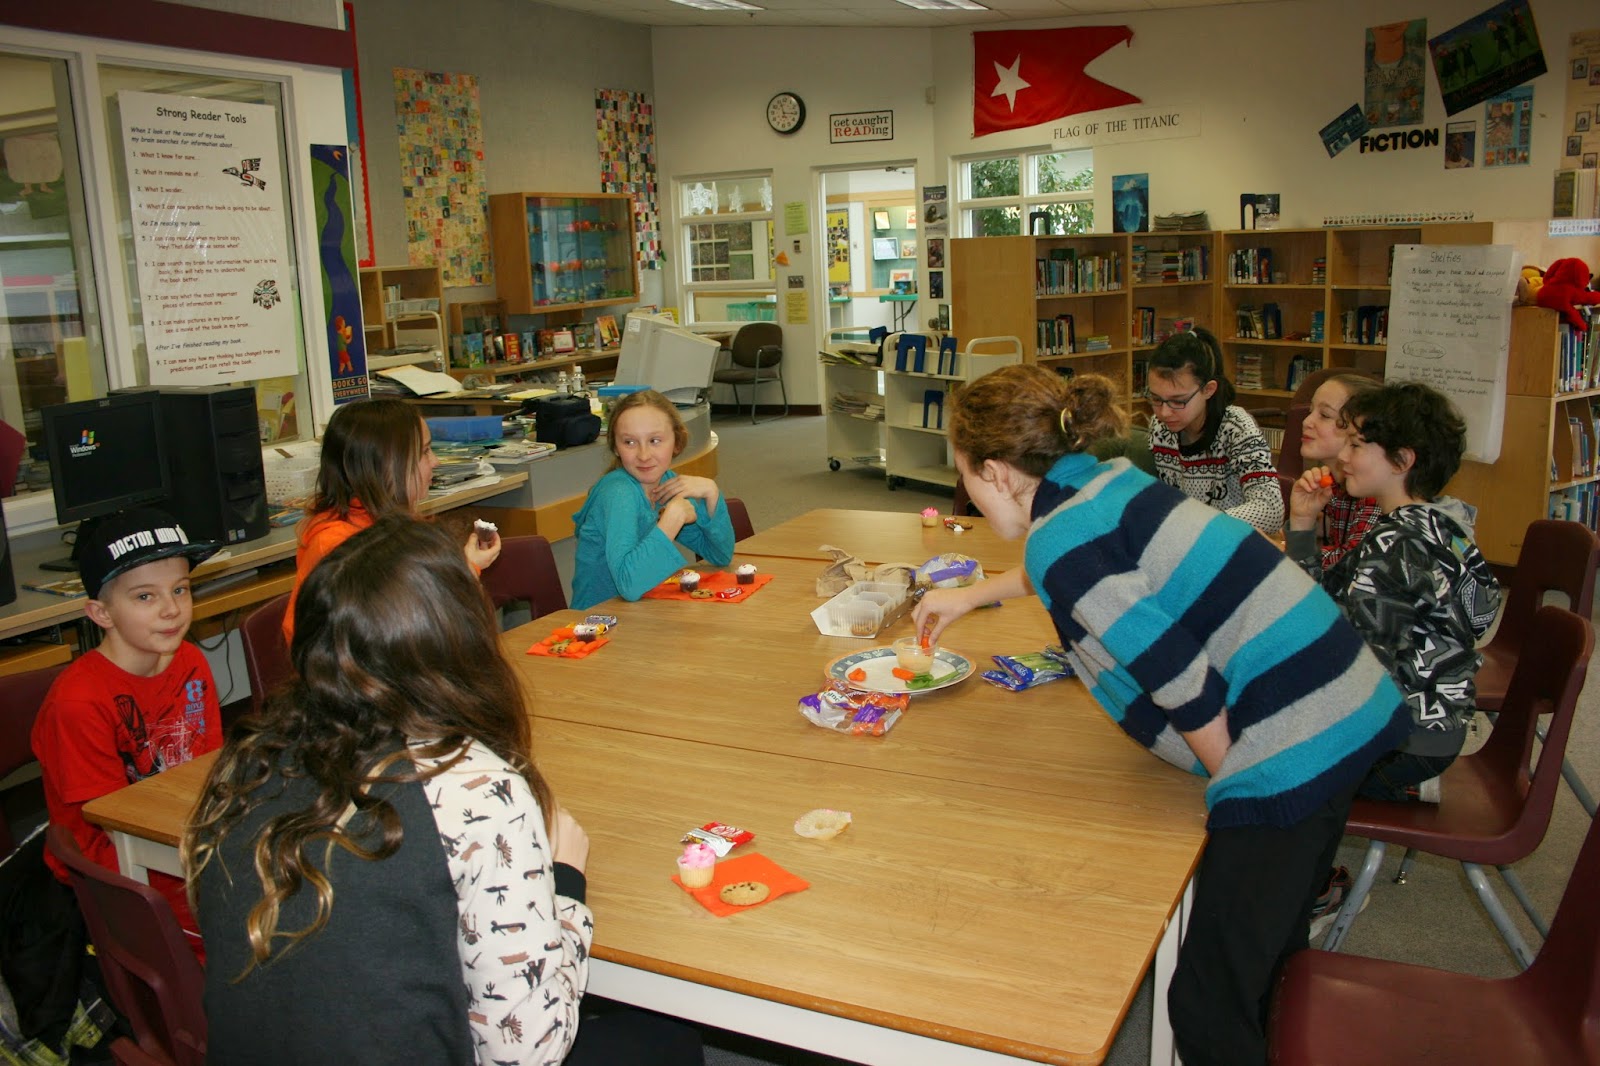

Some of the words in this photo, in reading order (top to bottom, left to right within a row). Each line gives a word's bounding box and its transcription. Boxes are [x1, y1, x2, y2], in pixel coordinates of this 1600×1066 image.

[156, 107, 187, 121] Strong
[190, 109, 221, 121] Reader
[224, 113, 247, 124] Tools
[1054, 125, 1080, 139] FLAG
[1085, 123, 1099, 136] OF
[1105, 120, 1127, 133] THE
[1132, 113, 1180, 130] TITANIC
[1360, 128, 1439, 153] FICTION
[1430, 251, 1462, 263] Shelfies
[332, 378, 355, 389] BOOKS
[70, 444, 97, 453] Windows
[107, 530, 155, 560] DOCTOR
